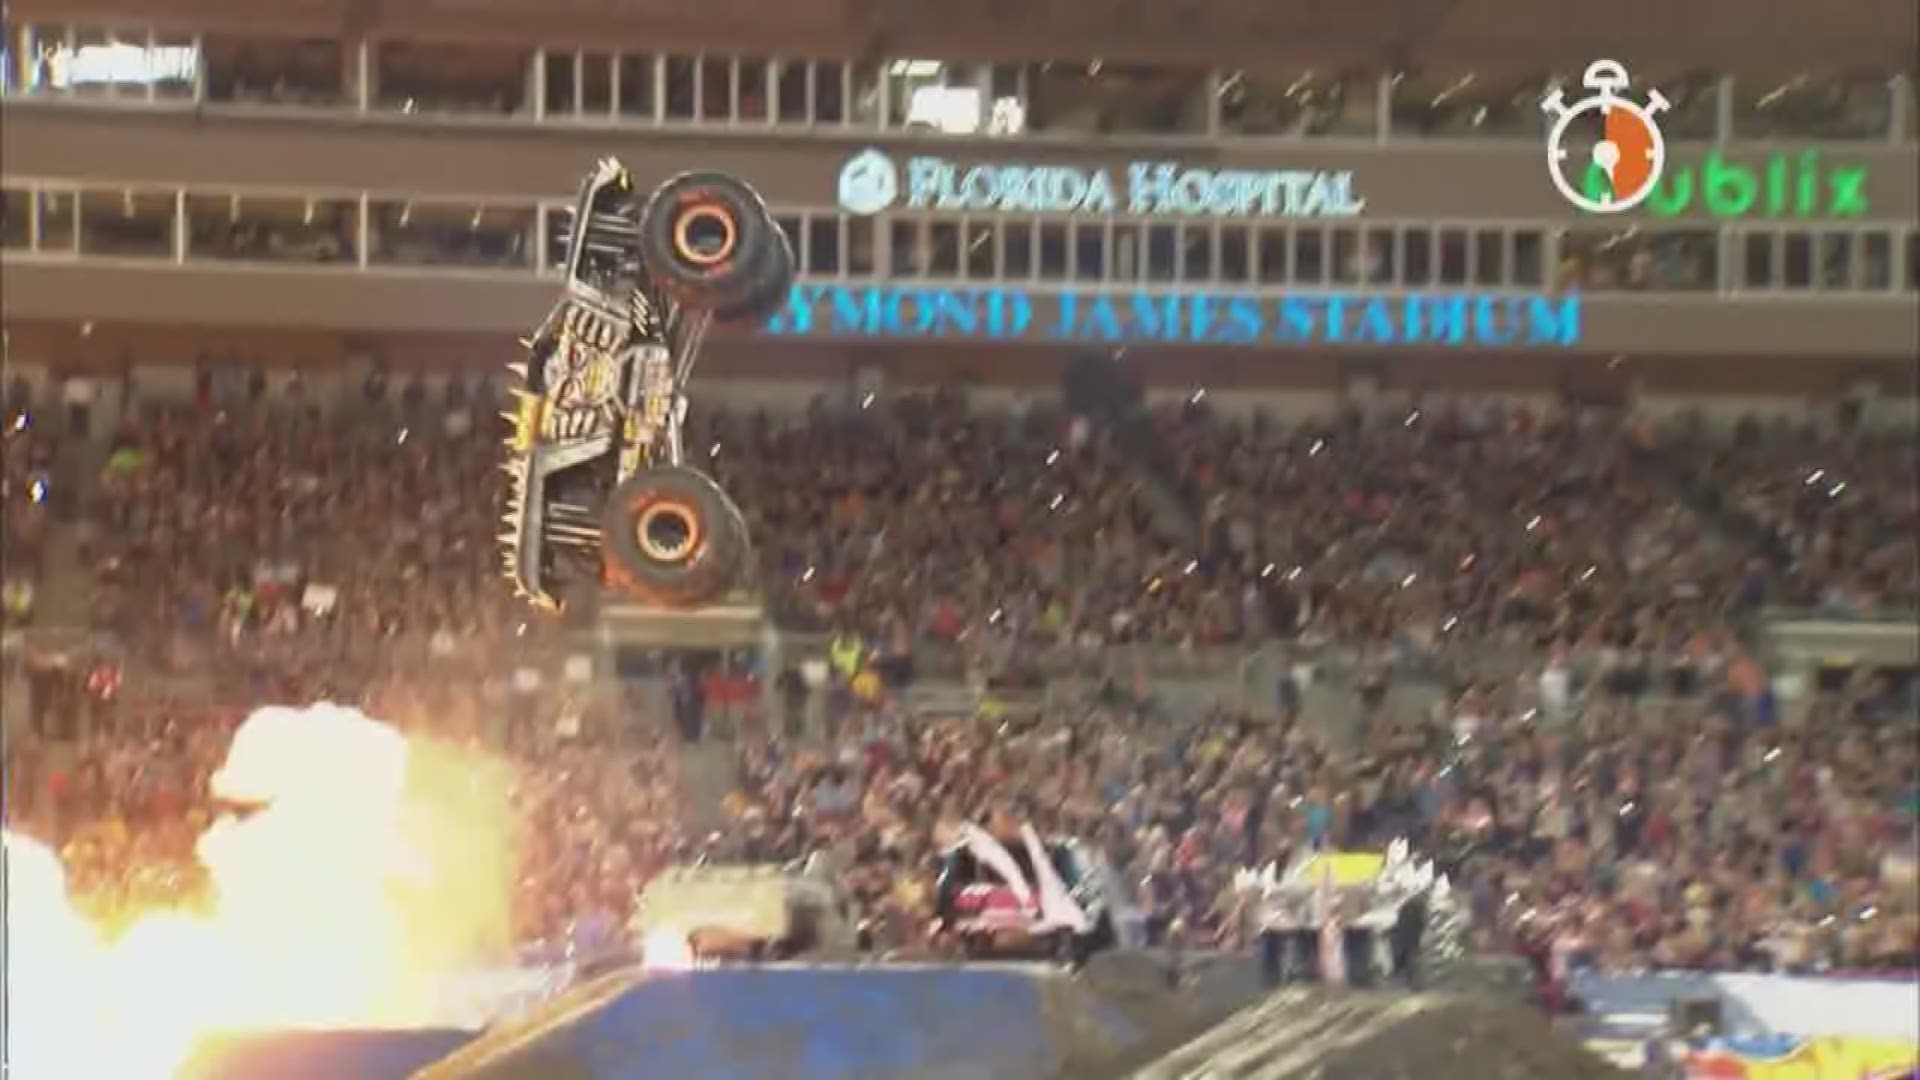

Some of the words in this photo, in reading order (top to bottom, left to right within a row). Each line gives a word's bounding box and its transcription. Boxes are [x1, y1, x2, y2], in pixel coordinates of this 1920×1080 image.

[907, 156, 1115, 213] FLORIDA
[1127, 161, 1363, 216] HOSPITAL
[767, 286, 1033, 338] YMOND
[1050, 287, 1264, 342] JAMES
[1277, 288, 1581, 346] STADIUM
